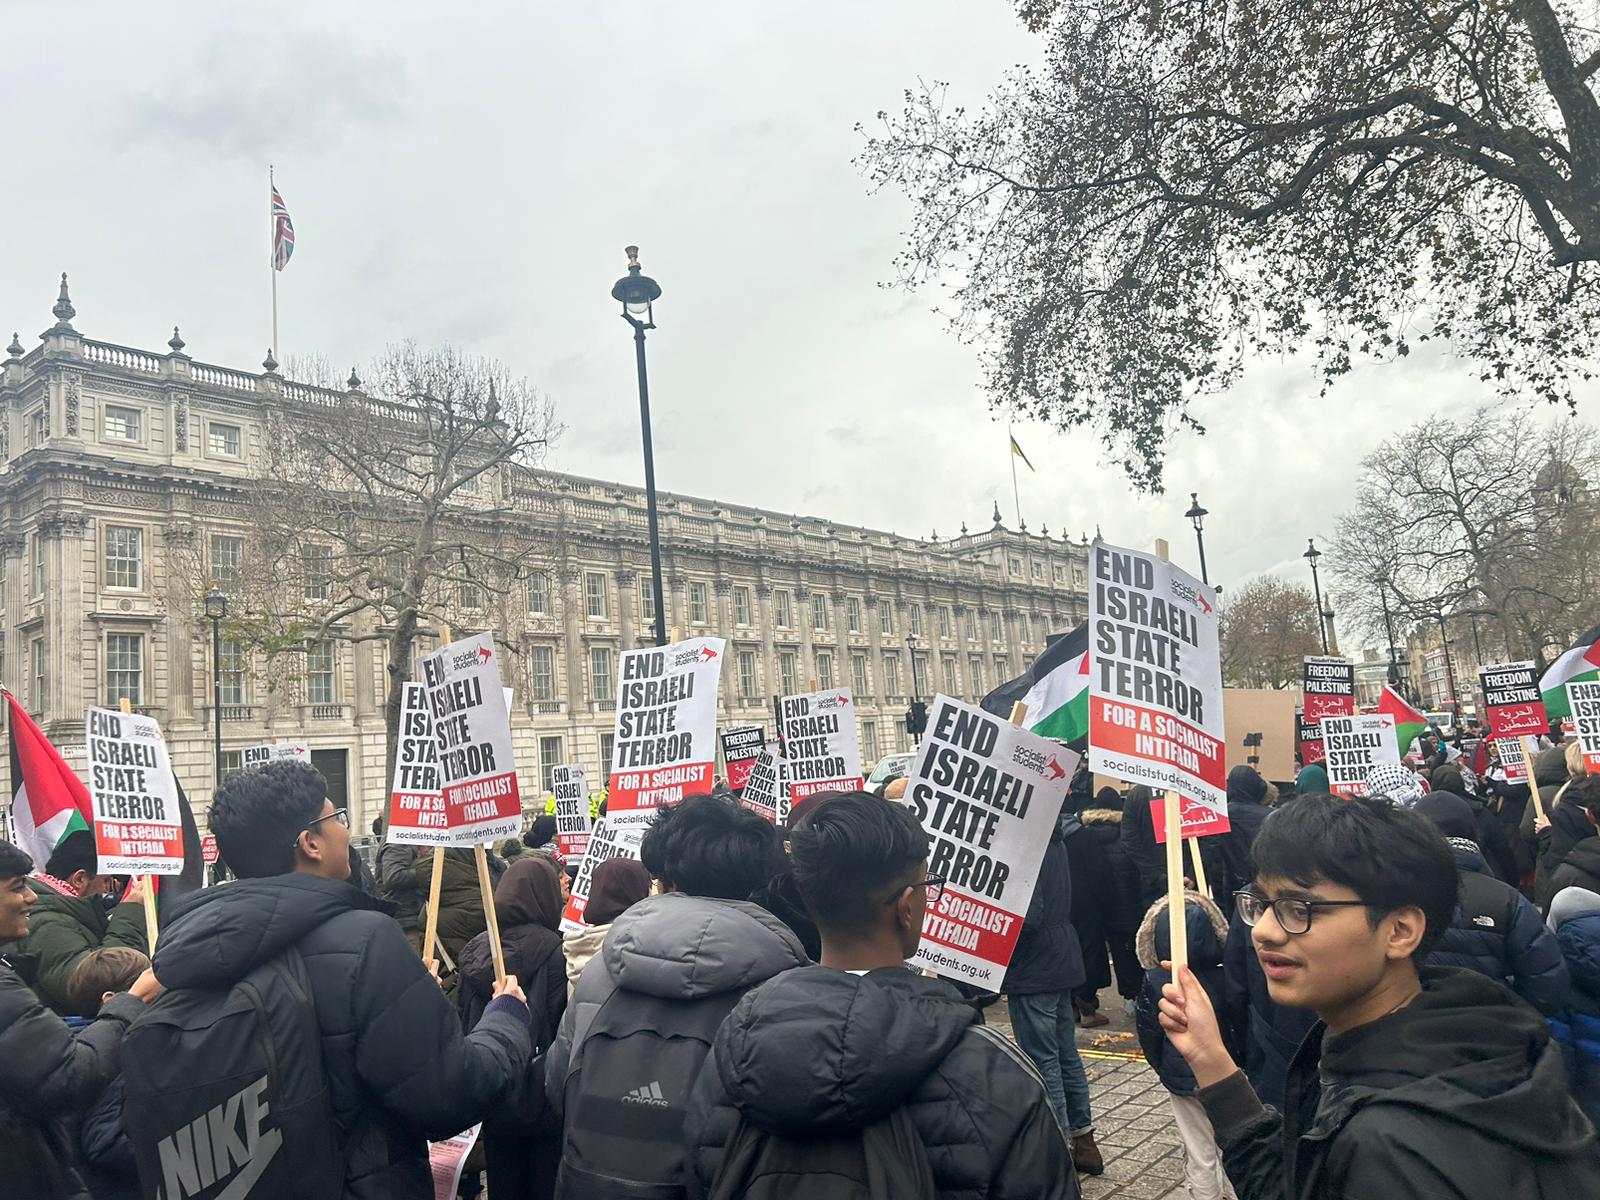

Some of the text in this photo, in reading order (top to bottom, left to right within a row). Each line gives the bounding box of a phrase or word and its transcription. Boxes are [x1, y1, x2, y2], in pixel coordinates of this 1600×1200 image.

[1096, 546, 1154, 590] END
[1096, 582, 1198, 648] ISRAELI
[453, 650, 477, 664] socialist
[675, 649, 699, 660] socialist
[1096, 620, 1181, 676] STATE
[454, 658, 480, 671] students
[624, 652, 664, 680] END
[674, 656, 699, 667] students
[1308, 665, 1349, 678] FREEDOM
[1096, 656, 1203, 725] TERROR
[1306, 681, 1352, 694] PALESTINE
[1485, 671, 1532, 687] FREEDOM
[406, 687, 428, 710] EN
[430, 676, 482, 720] ISAELI
[622, 672, 694, 710] ISRAELI
[1486, 688, 1540, 704] PALESTINE
[1570, 684, 1600, 700] END
[784, 697, 810, 718] END
[1498, 706, 1534, 720] الحرية
[90, 710, 122, 739] END
[620, 705, 676, 738] STATE
[786, 714, 839, 740] ISRAELI
[933, 702, 999, 758] END
[1103, 703, 1218, 761] FOR A SOCIALIST
[1325, 719, 1352, 734] END
[1498, 716, 1541, 732] لفلسطين
[618, 732, 692, 768] TERROR
[724, 731, 760, 746] FREEDOM
[788, 736, 829, 760] STATE
[1326, 733, 1382, 750] ISRAELI
[91, 738, 158, 768] ISRAELI
[244, 747, 270, 762] END
[402, 739, 438, 764] STA
[440, 742, 496, 782] TEROR
[759, 751, 773, 766] END
[1014, 745, 1048, 765] socialist
[1136, 733, 1201, 774] INTIFADA
[1329, 750, 1372, 766] STATE
[1502, 754, 1524, 764] TERR
[1590, 754, 1600, 764] FO
[554, 768, 569, 784] END
[790, 756, 846, 780] TERROR
[1012, 754, 1046, 775] students
[1331, 766, 1376, 782] TERR
[93, 765, 147, 792] STATE
[400, 765, 440, 790] TER
[618, 765, 706, 790] FOR A SOCIALIST
[748, 774, 774, 794] STATE
[920, 742, 1034, 820] ISRAELI
[637, 786, 684, 806] INTFADA
[796, 785, 810, 796] FOR
[810, 784, 816, 796] A
[96, 792, 166, 820] TERROR
[400, 796, 421, 810] FOR
[422, 796, 430, 810] A
[556, 800, 578, 816] STATE
[909, 784, 1000, 850] STATE
[102, 824, 178, 840] FOR A SOCIALIST
[928, 833, 1010, 900] RROR
[938, 891, 1014, 936] SOCIALIST
[922, 912, 980, 951] NTIFADA
[916, 948, 992, 981] students.org.uk
[157, 1074, 274, 1200] NIKE
